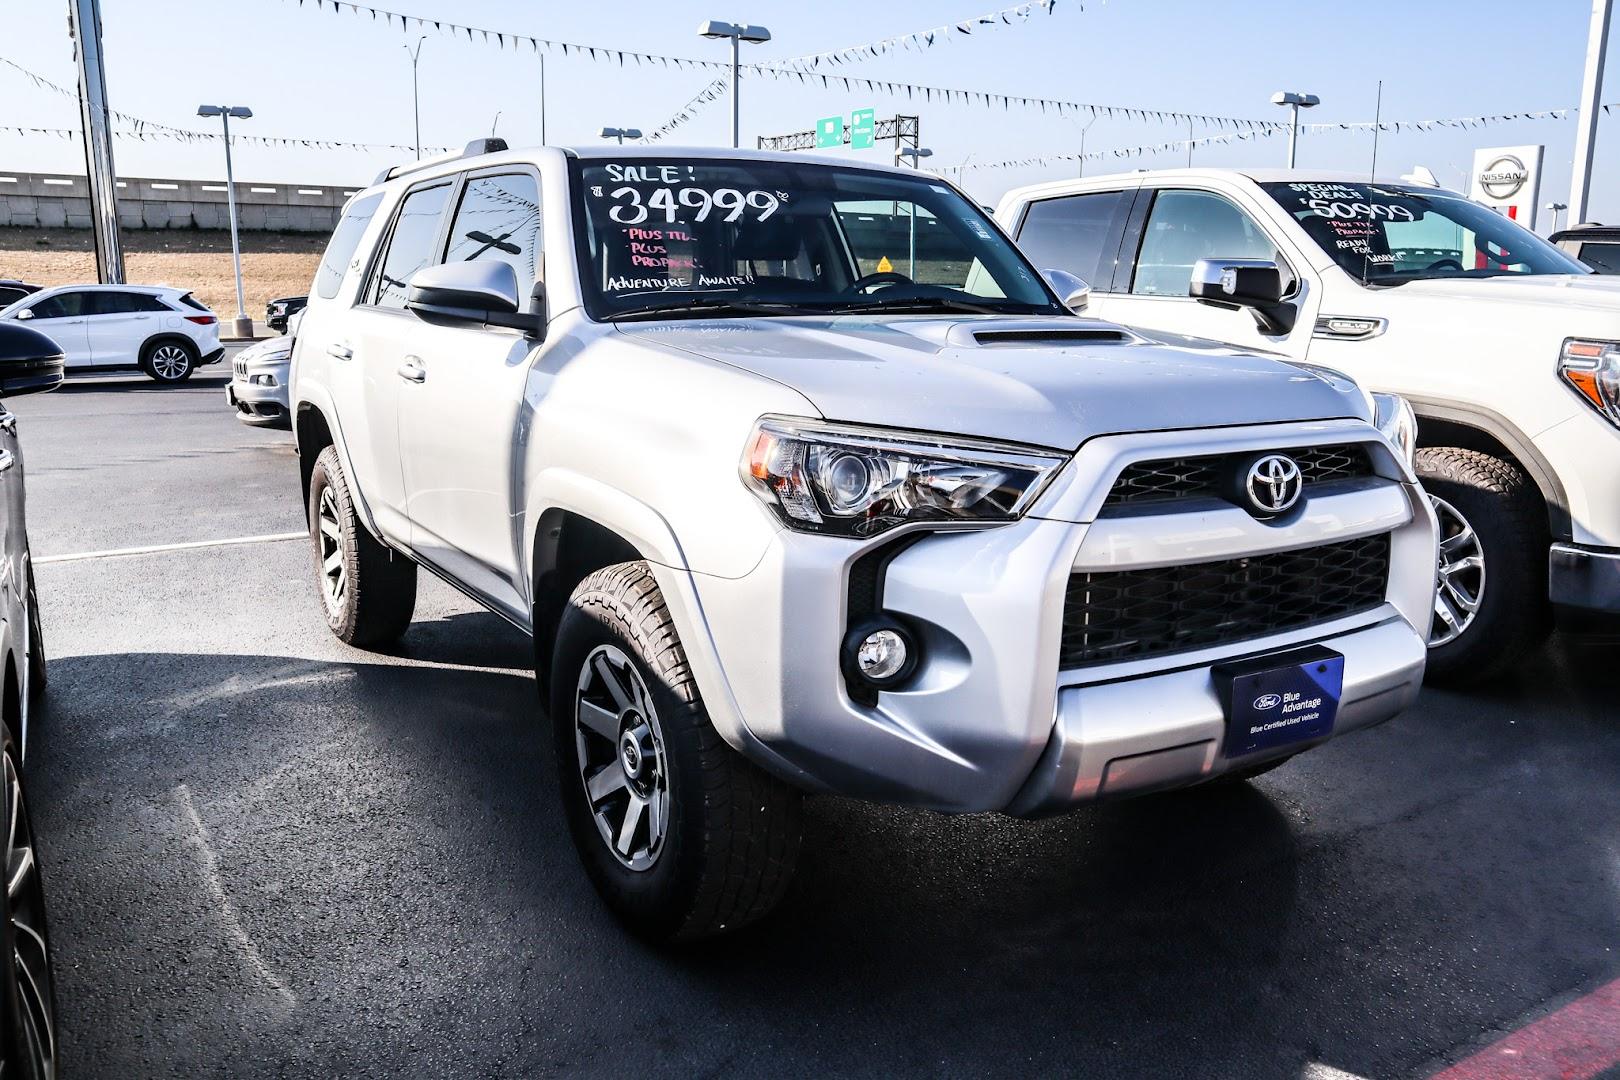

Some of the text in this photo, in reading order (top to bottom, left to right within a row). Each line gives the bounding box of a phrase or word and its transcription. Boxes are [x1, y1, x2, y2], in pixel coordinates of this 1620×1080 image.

[1481, 172, 1522, 181] NISSAN
[1288, 183, 1354, 192] SPECIAL
[1308, 190, 1363, 199] DEAL!!
[630, 242, 667, 254] PLUS
[1335, 239, 1367, 249] READY
[1352, 246, 1373, 254] FOR
[1283, 692, 1301, 703] Blue
[1281, 697, 1322, 714] Advantage
[1250, 713, 1320, 734] Blue Certified Used Vehicle
